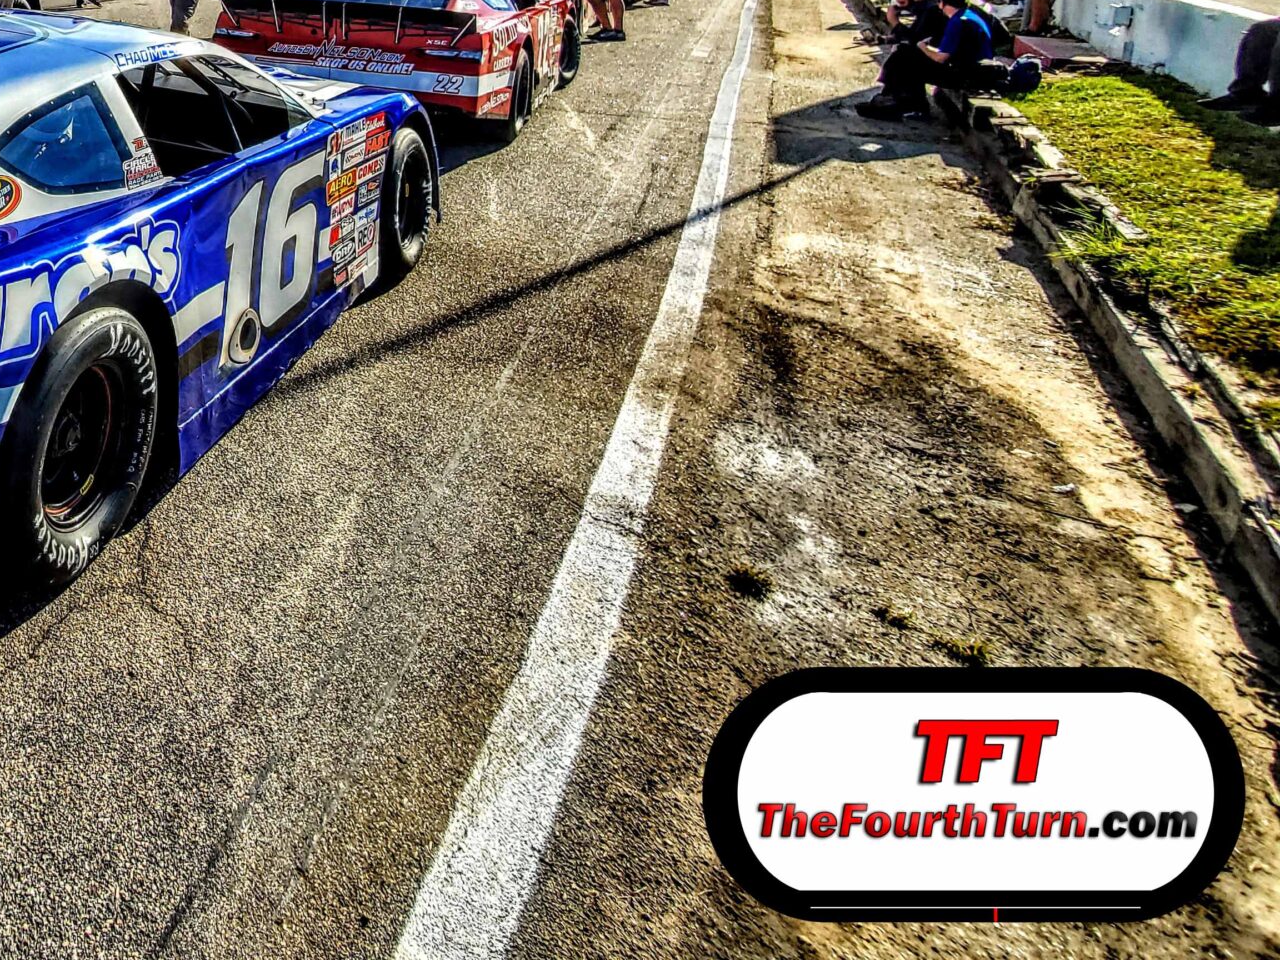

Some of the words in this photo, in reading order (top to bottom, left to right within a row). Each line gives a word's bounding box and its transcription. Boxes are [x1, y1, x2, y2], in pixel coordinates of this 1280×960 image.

[114, 49, 149, 67] CHAD
[314, 56, 348, 69] SHOP
[348, 59, 366, 71] US
[369, 62, 415, 76] ONLINE!
[432, 74, 464, 94] 22
[367, 131, 392, 155] FAST
[124, 152, 155, 170] CIRCLE
[329, 172, 353, 194] AERO
[220, 150, 326, 368] 16
[335, 244, 352, 259] DRP
